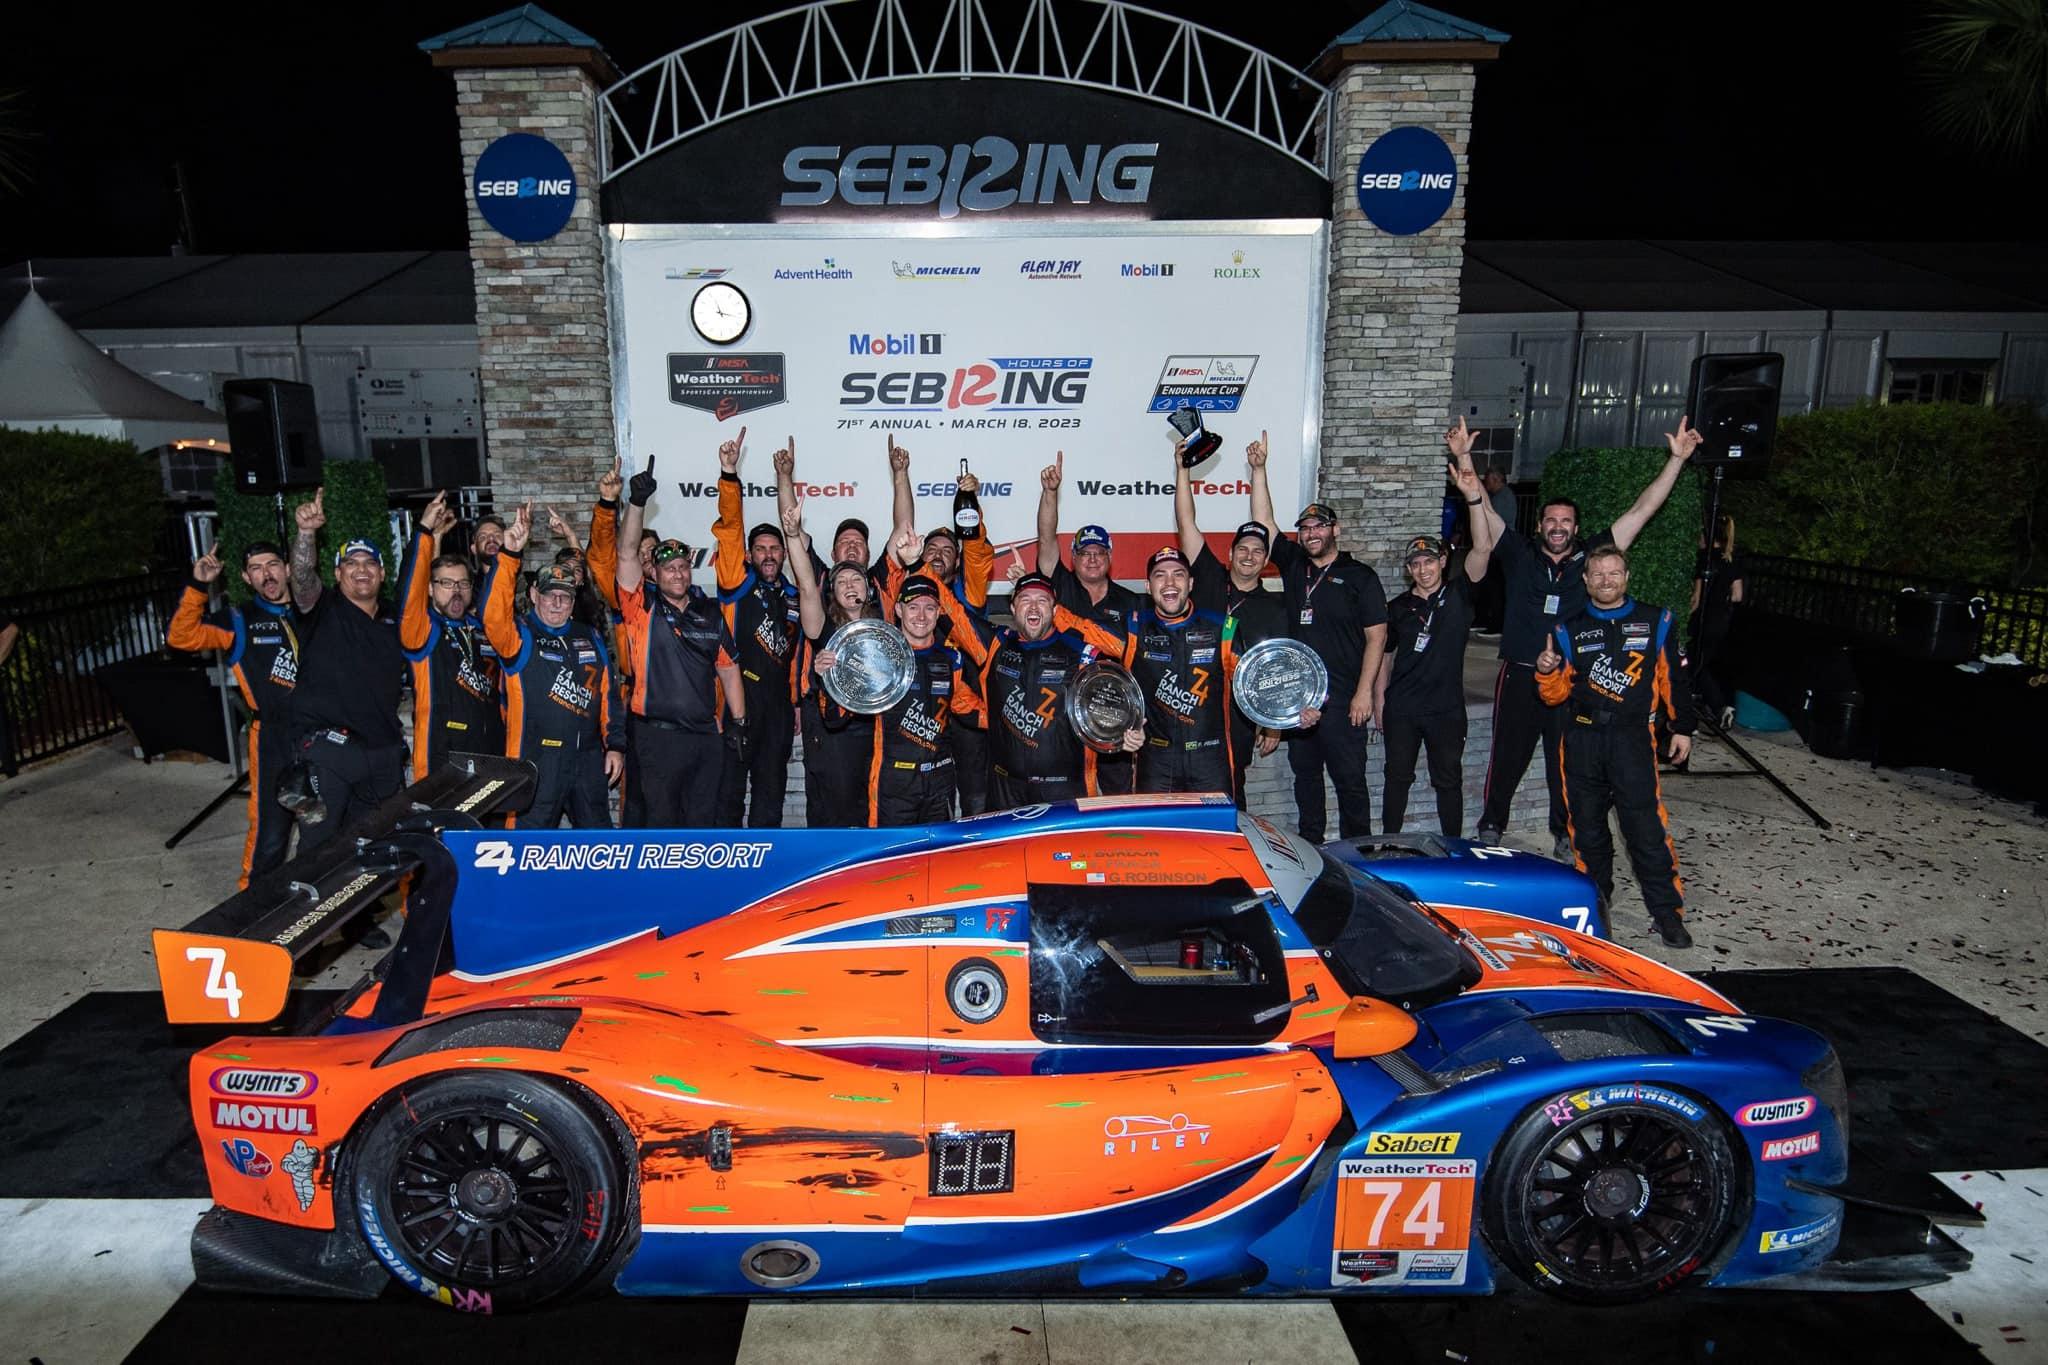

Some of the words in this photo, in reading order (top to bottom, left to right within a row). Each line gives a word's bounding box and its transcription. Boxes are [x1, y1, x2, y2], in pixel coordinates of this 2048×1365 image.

[774, 268, 852, 280] AdventHealth
[916, 266, 981, 276] MICHELIN
[1020, 261, 1054, 273] ALAN
[1056, 260, 1082, 274] JAY
[1121, 264, 1159, 276] Mobil
[1163, 264, 1172, 276] 1
[1214, 268, 1261, 278] ROLEX
[850, 334, 915, 355] Mobil
[923, 334, 939, 354] 1
[1007, 360, 1060, 369] HOURS
[1063, 359, 1089, 368] OF
[1178, 368, 1204, 376] IMSA
[675, 373, 780, 384] WeatherTech
[1161, 385, 1217, 396] ENDURANCE
[1219, 385, 1239, 395] CUP
[870, 419, 932, 429] ANNUAL
[951, 419, 1007, 429] MARCH
[1038, 418, 1081, 428] 2023
[679, 482, 858, 498] WetheTech
[1077, 480, 1252, 496] WeatheTech
[1158, 678, 1200, 706] RANCH
[1154, 689, 1194, 715] RESORT
[1005, 694, 1044, 727] RANCH
[1002, 703, 1038, 738] RESORT
[519, 844, 634, 871] RANCH
[637, 842, 772, 869] RESORT
[216, 1102, 313, 1134] MOTUL
[1104, 1131, 1211, 1156] RILEY
[1374, 1134, 1452, 1153] Sabelt
[1765, 1136, 1819, 1158] MOTUL
[1345, 1164, 1471, 1174] WeatherTech
[1364, 1182, 1445, 1246] 74
[1790, 1216, 1838, 1243] MICHELIN
